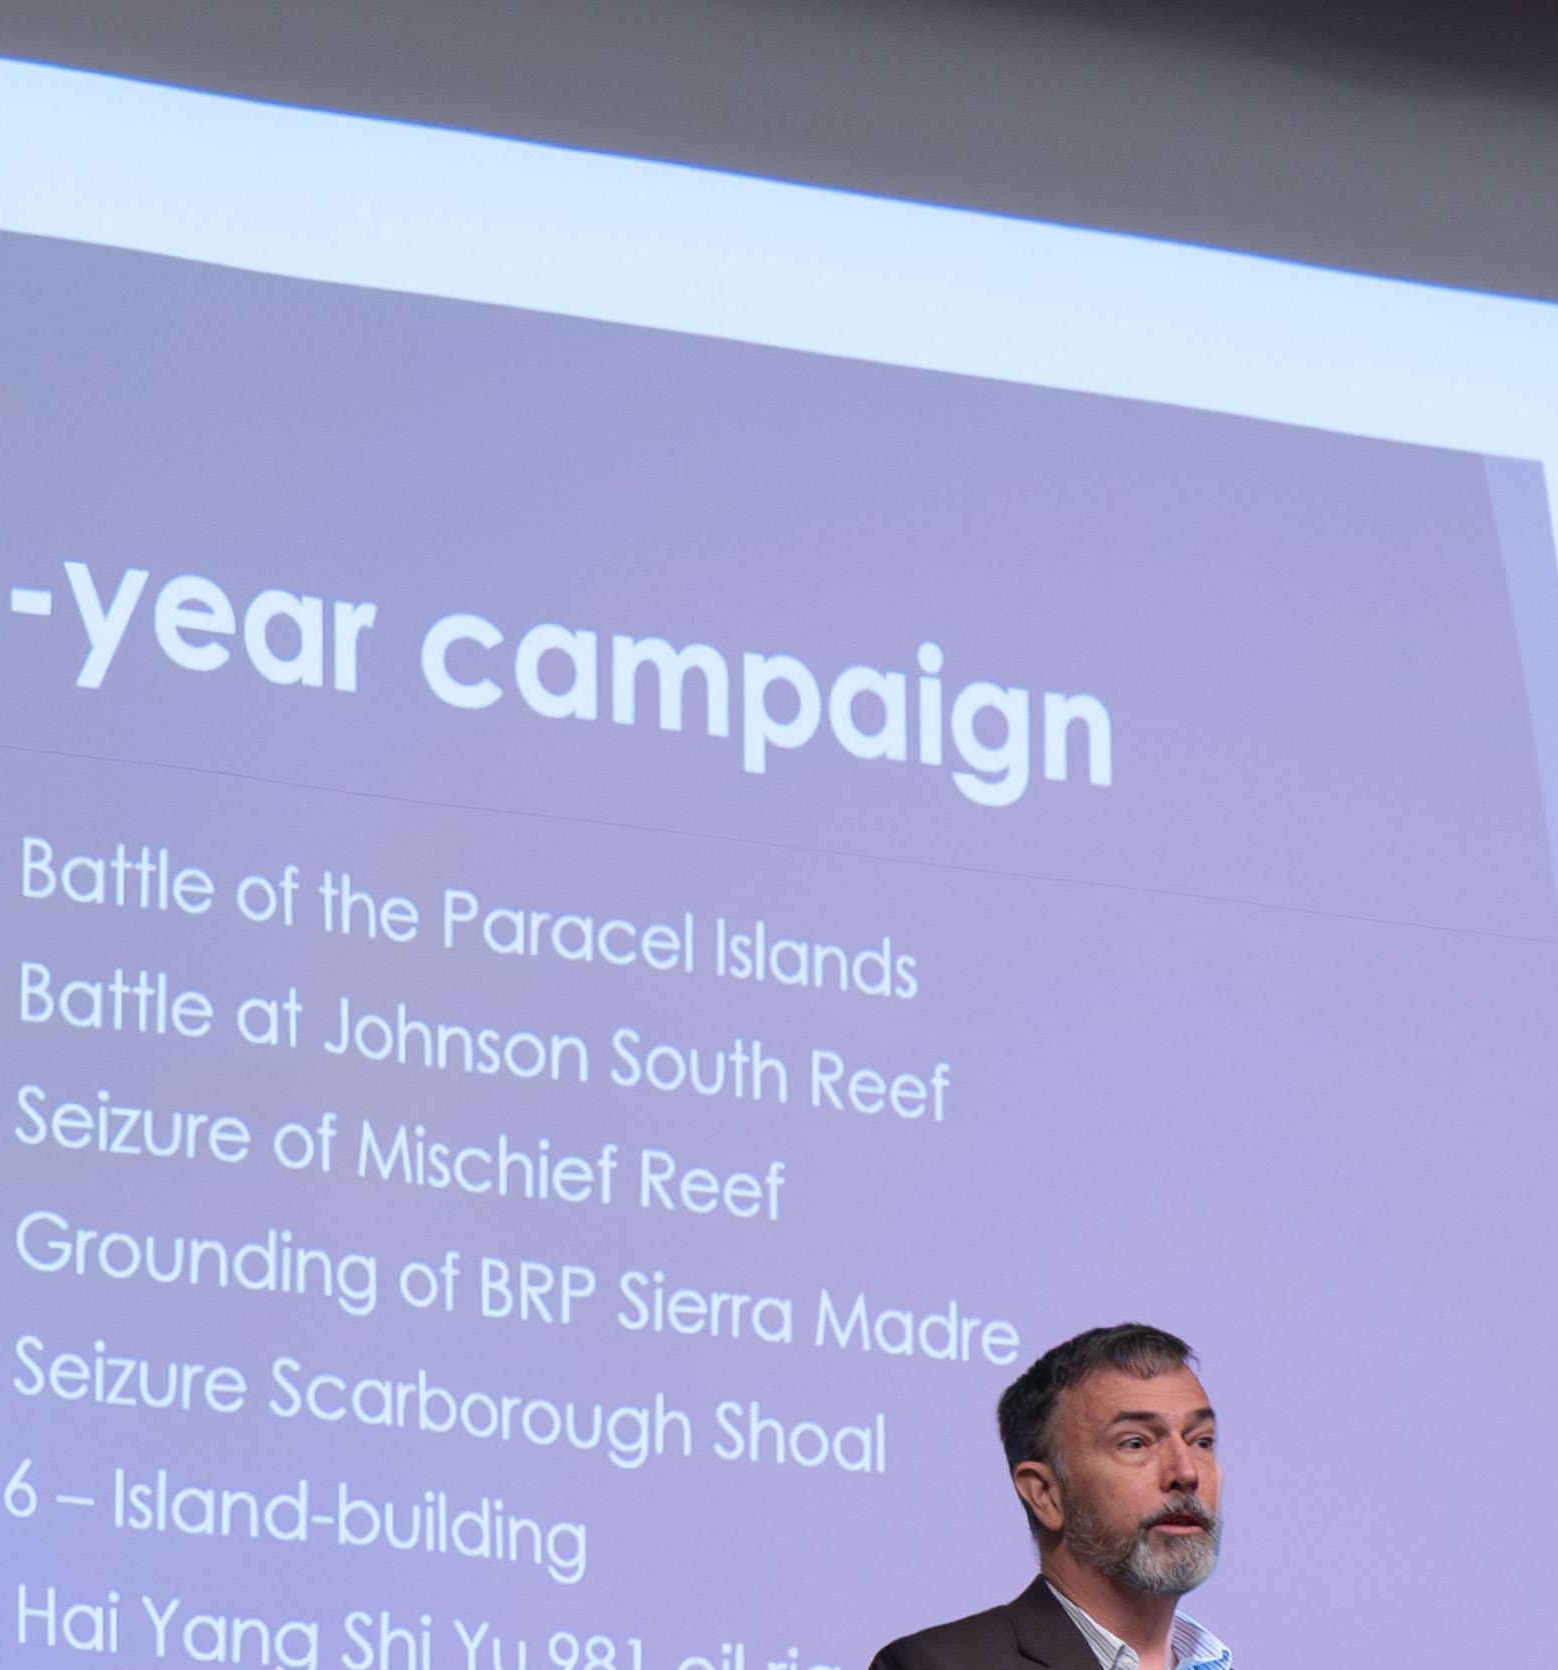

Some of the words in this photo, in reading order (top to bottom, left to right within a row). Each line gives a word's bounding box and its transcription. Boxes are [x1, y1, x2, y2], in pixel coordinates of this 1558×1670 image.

[420, 612, 1114, 808] campaign
[21, 836, 215, 915] Battle
[236, 863, 300, 926] of
[318, 870, 419, 943] the
[443, 888, 694, 973] Paracel
[716, 917, 919, 1000] Islands
[20, 961, 214, 1038] Battle
[236, 986, 304, 1049] at
[323, 996, 589, 1083] Johnson
[610, 1027, 788, 1104] South
[811, 1048, 951, 1122] Reef
[14, 1084, 251, 1163] Seizure
[273, 1111, 338, 1173] of
[357, 1119, 619, 1205] Mischief
[640, 1148, 786, 1221] Reef
[15, 1210, 377, 1317] Grounding
[399, 1250, 461, 1312] of
[481, 1256, 597, 1325] BRP
[617, 1269, 793, 1344] Sierra
[815, 1288, 1021, 1366] Madre
[13, 1335, 248, 1413] Seizure
[269, 1356, 692, 1470] Scarborough
[713, 1400, 886, 1474] Shoal
[114, 1467, 587, 1585] Island-building
[17, 1583, 120, 1654] Hai
